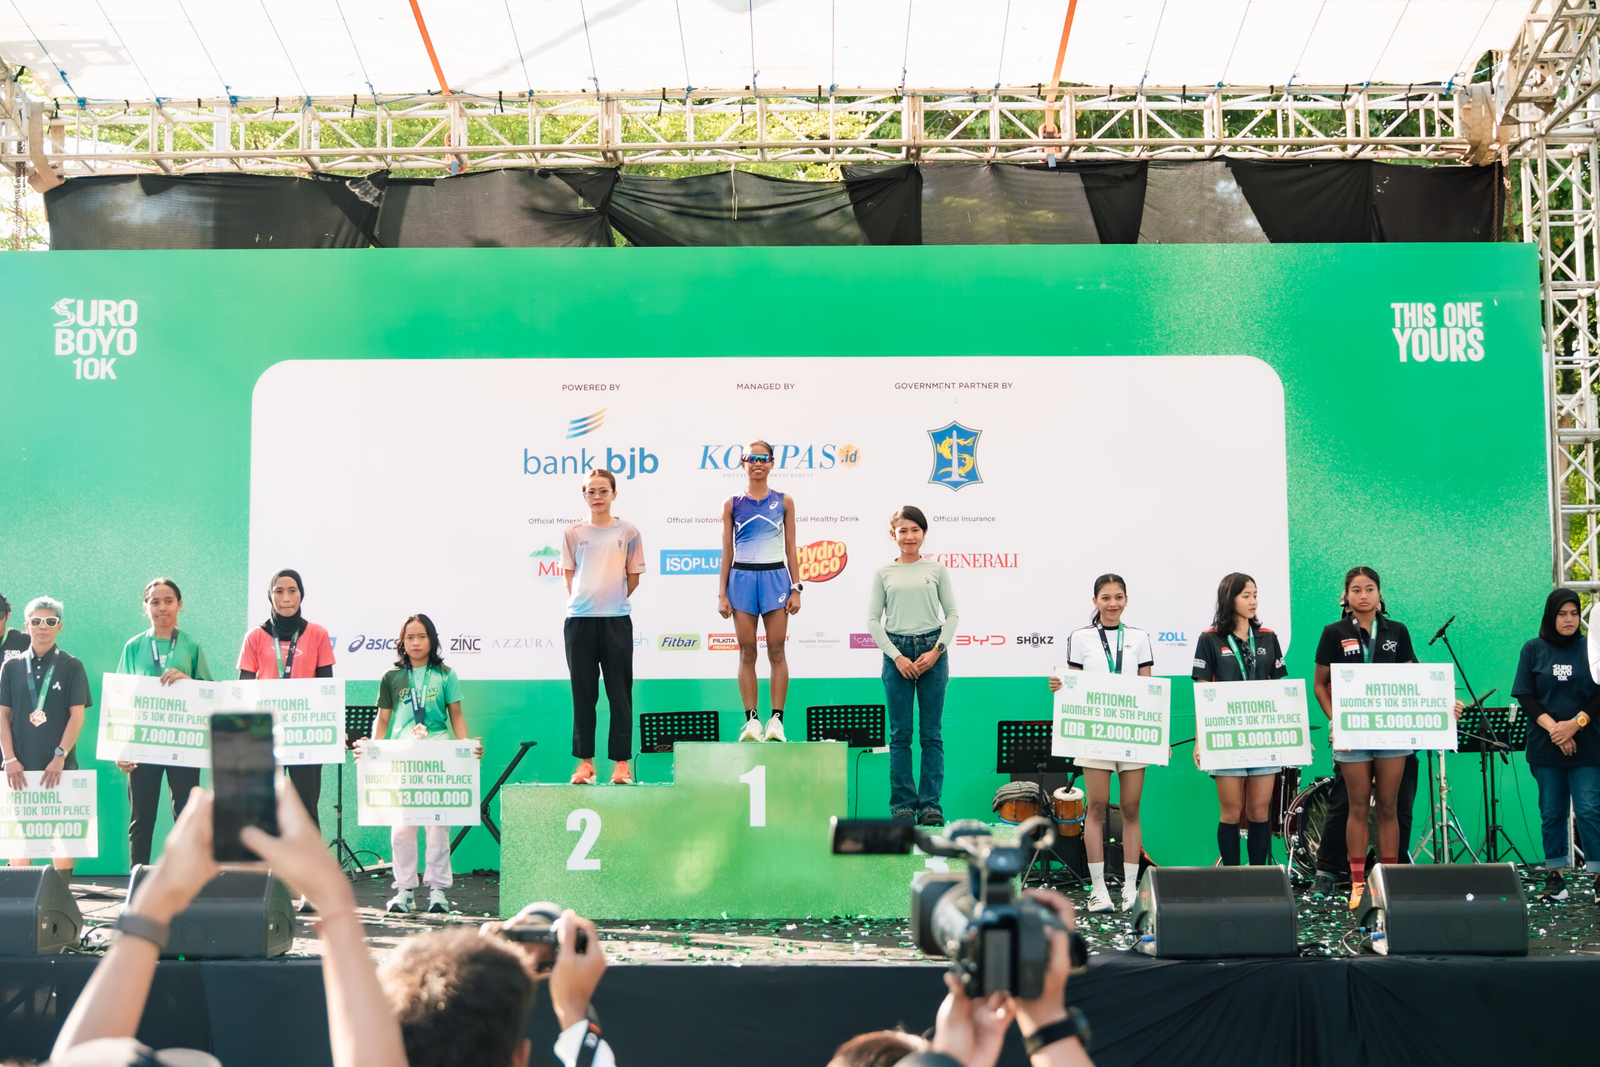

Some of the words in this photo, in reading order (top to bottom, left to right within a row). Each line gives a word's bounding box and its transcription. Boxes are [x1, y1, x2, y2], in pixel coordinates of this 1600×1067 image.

[51, 298, 138, 327] SURO
[1390, 302, 1436, 328] THIS
[1443, 302, 1483, 327] ONE
[55, 328, 137, 356] BOYO
[1392, 328, 1484, 362] YOURS
[73, 357, 117, 380] 10K
[894, 382, 956, 390] GOVERNMENT
[959, 382, 1000, 390] PARTNER
[1002, 382, 1013, 390] BY
[524, 448, 596, 475] bank
[606, 447, 659, 480] bjb
[796, 542, 846, 565] Hydro
[937, 554, 1018, 568] GENERALI
[451, 637, 481, 650] ZINC
[492, 639, 554, 648] AZZURA
[662, 636, 698, 648] Fitbar
[956, 635, 1006, 646] BYD
[1016, 636, 1054, 644] SHOKZ
[1158, 632, 1188, 642] ZOLL
[1366, 684, 1420, 696] NATIONAL
[134, 696, 188, 712] NATIONAL
[1086, 692, 1138, 708] NATIONAL
[1227, 700, 1278, 714] NATIONAL
[1340, 698, 1381, 708] WOMEN'S
[1384, 698, 1399, 708] 10K
[1402, 698, 1418, 708] 9TH
[1421, 698, 1447, 708] PLACE
[108, 709, 148, 720] WOMEN'S
[151, 712, 165, 722] 10K
[168, 713, 183, 723] 8TH
[186, 715, 210, 726] PLAC
[292, 712, 307, 722] 6TH
[311, 712, 337, 722] PLACE
[1062, 704, 1100, 717] WOMEN'S
[1104, 708, 1117, 718] 10K
[1120, 709, 1135, 720] 5TH
[1138, 711, 1162, 722] PLACE
[1205, 716, 1242, 727] WOMEN'S
[1246, 715, 1259, 725] 10K
[1262, 714, 1276, 724] 7TH
[1278, 714, 1301, 724] PLACE
[1347, 714, 1369, 728] IDR
[1375, 714, 1442, 728] 5.000.000
[114, 726, 135, 740] IDR
[141, 728, 203, 746] 7.000.000
[1064, 721, 1086, 736] IDR
[1091, 724, 1158, 743] 12.000.000
[1212, 734, 1232, 748] IDR
[1238, 730, 1298, 746] 9.000.000
[391, 760, 446, 773] NATIONAL
[365, 775, 406, 784] WOMEN'S
[410, 775, 423, 784] 10K
[427, 775, 443, 784] 4TH
[446, 775, 472, 784] PLACE
[6, 791, 62, 804] NATIONAL
[369, 791, 392, 805] IDR
[397, 791, 469, 805] 13.000.000
[740, 765, 766, 827] 1
[23, 806, 38, 816] 10K
[42, 806, 60, 815] 10TH
[64, 806, 90, 815] PLACE
[14, 822, 82, 837] 4.000.000
[566, 808, 602, 870] 2
